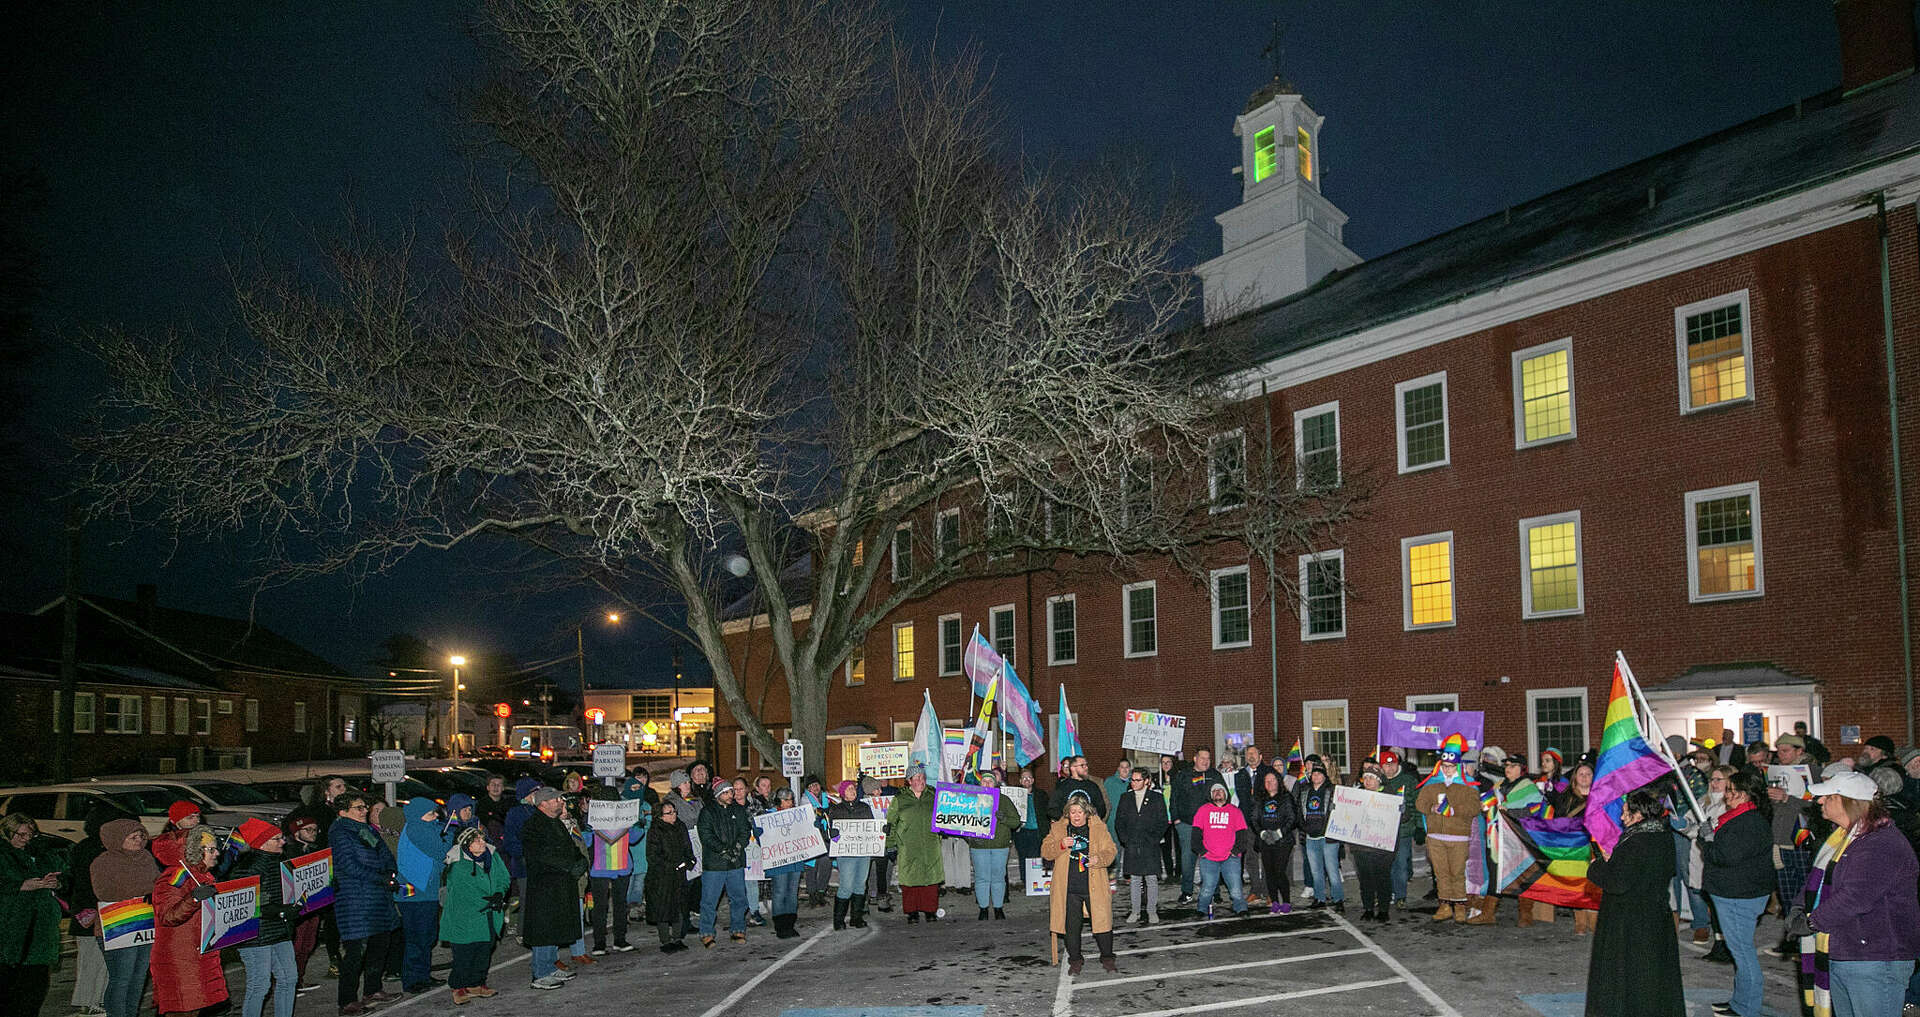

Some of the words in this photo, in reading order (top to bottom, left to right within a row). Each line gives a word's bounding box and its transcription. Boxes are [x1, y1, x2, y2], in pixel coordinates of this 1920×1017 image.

[1126, 711, 1185, 728] EVERYYNE
[1124, 735, 1177, 751] ENFIELD
[760, 807, 808, 828] FREEDOM
[935, 814, 990, 827] SURVIVING
[1209, 811, 1229, 825] PFLAG
[781, 825, 792, 837] OF
[834, 821, 885, 833] SUFFIELD
[761, 834, 820, 861] EXPRESSION
[838, 842, 881, 855] ENFIELD
[295, 861, 328, 883] SUFFIELD
[302, 877, 324, 893] CARES
[217, 890, 254, 911] SUFFIELD
[223, 906, 249, 925] CARES
